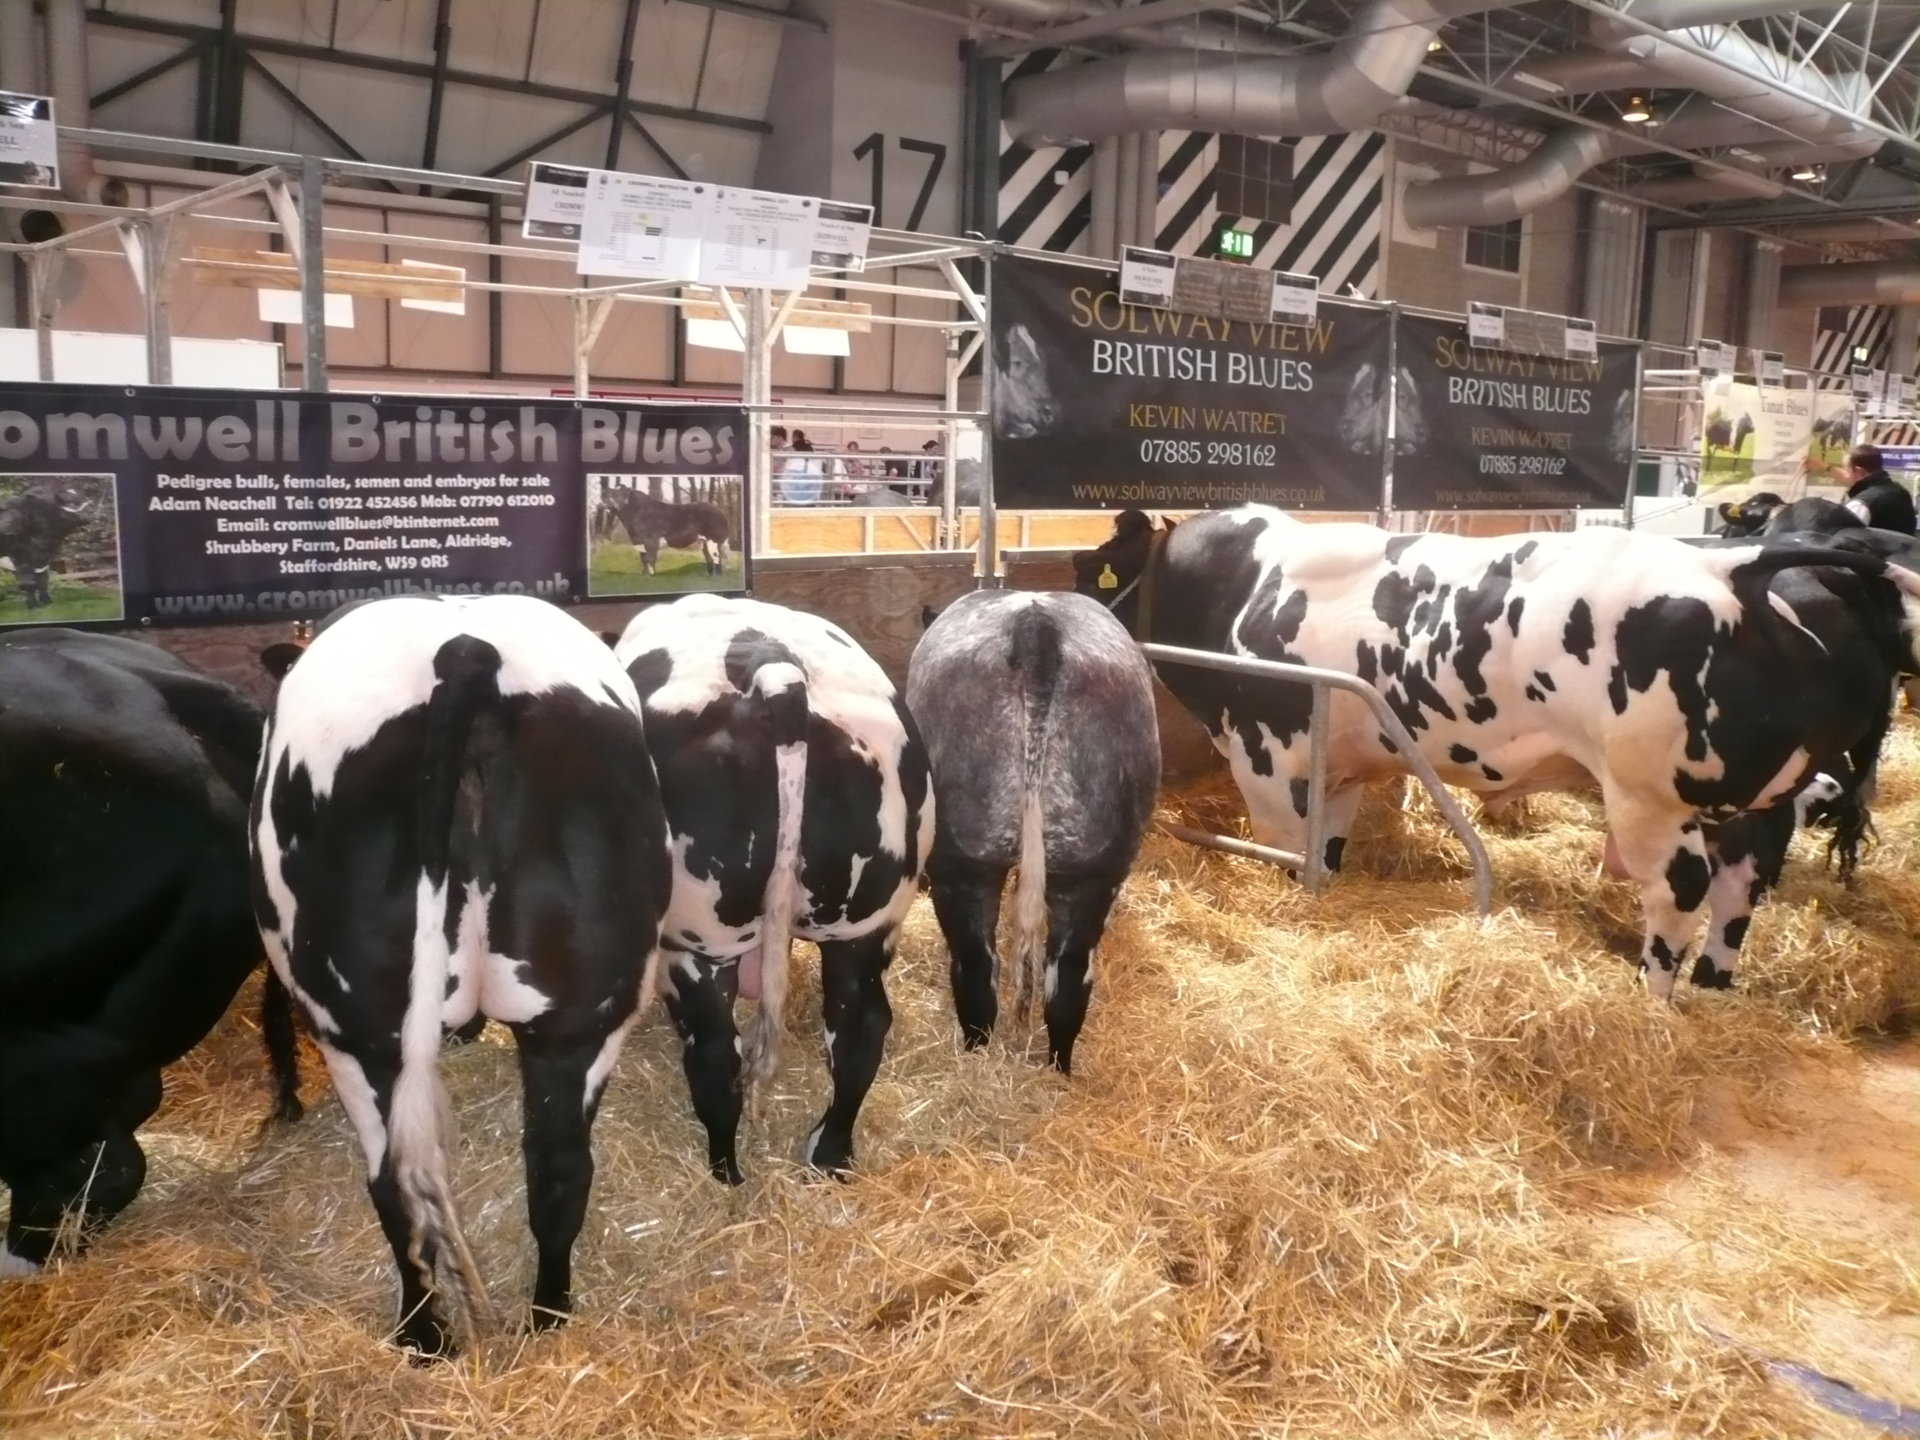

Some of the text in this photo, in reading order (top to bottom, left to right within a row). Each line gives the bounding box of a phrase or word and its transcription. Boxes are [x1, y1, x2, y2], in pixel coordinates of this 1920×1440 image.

[853, 132, 947, 232] 17
[1092, 339, 1313, 392] BRITISH BLUES
[1449, 376, 1592, 414] BRITISH BLUES
[1129, 403, 1287, 435] KEVIN WATRET
[330, 401, 558, 463] British
[580, 407, 734, 465] Blues
[1472, 426, 1516, 446] KEVIN
[1140, 439, 1276, 467] 07885 298162
[1479, 454, 1567, 475] 07885 298162
[157, 473, 550, 491] Pedigree bulls, females, semen and embryos for sale
[148, 494, 555, 511] Adam Neachell Tel: 01922 452456 Mob: 07790 612010
[217, 515, 499, 532] Email: cromwellblues@btinternet.com
[205, 533, 512, 555] Shrubbery Farm, Daniels Lane, Aldridge,
[279, 557, 382, 574] Staffordshire,
[385, 556, 417, 569] WS9
